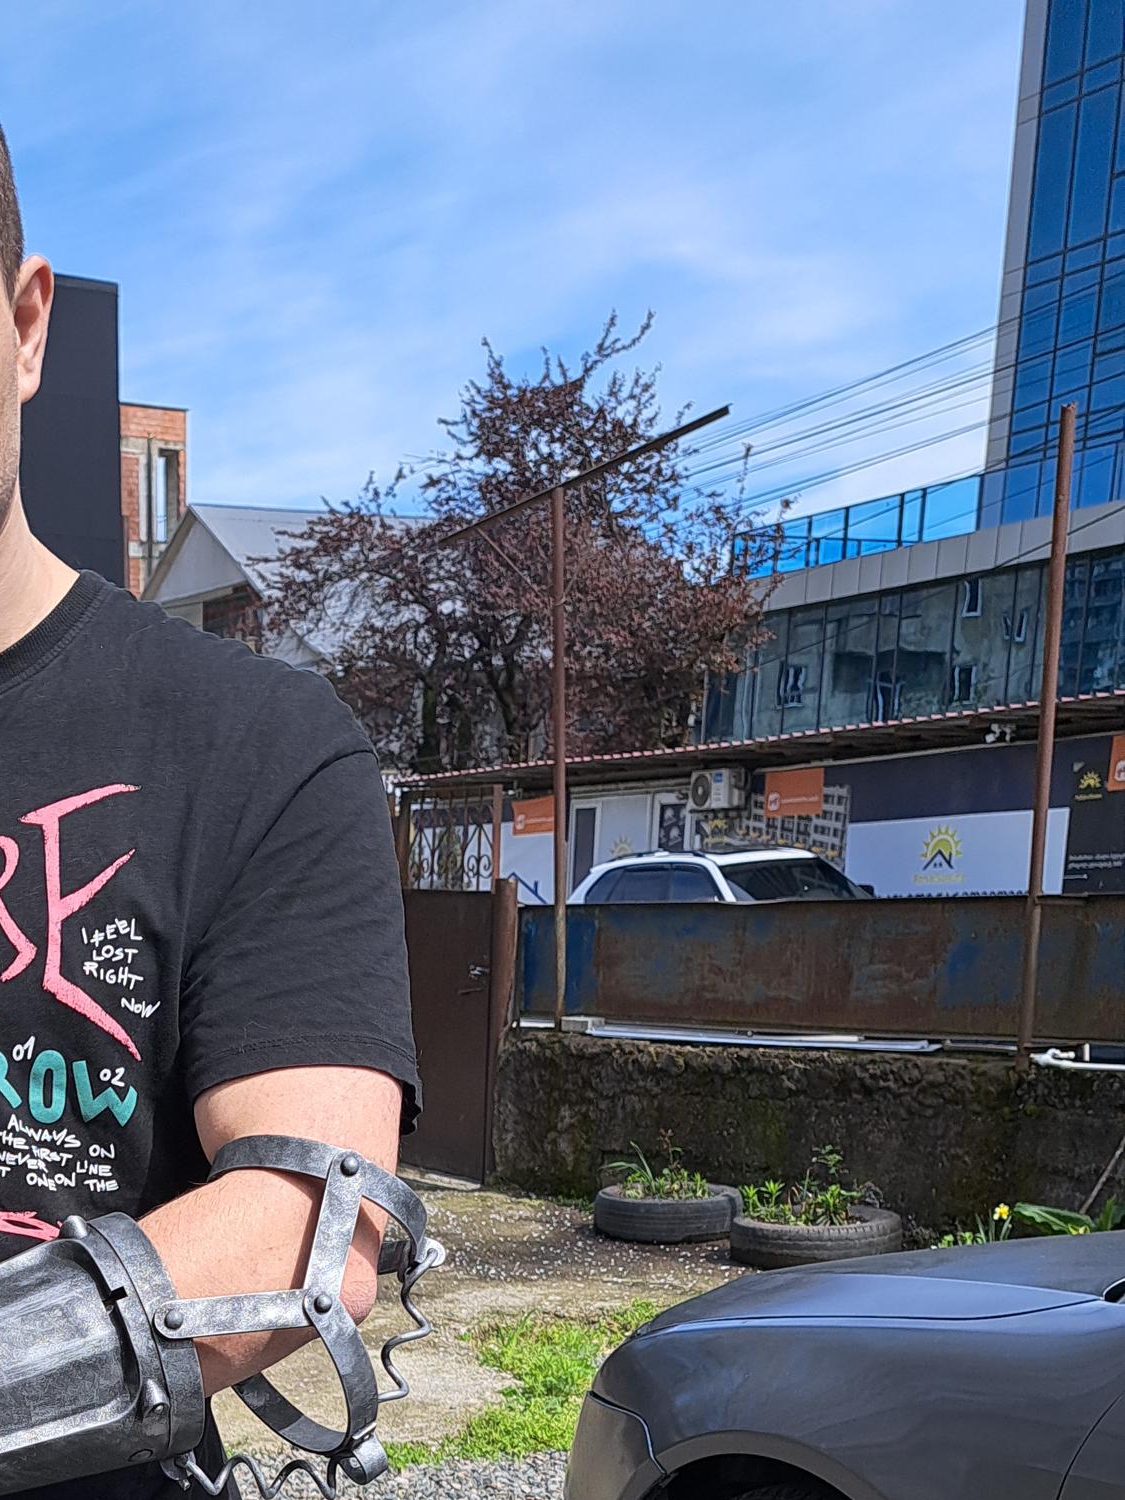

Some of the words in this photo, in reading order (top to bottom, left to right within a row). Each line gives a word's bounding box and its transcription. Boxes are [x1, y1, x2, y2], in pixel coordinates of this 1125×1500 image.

[81, 926, 88, 945] I
[90, 918, 143, 947] FEEL
[92, 944, 139, 964] LOST
[82, 961, 144, 990] RIGHT
[121, 997, 161, 1018] NOW
[12, 1035, 36, 1061] 01
[99, 1066, 126, 1087] 02
[7, 1113, 81, 1148] ALWAYS
[88, 1143, 115, 1159] ON
[76, 1160, 113, 1176] LINE
[83, 1179, 119, 1192] THE
